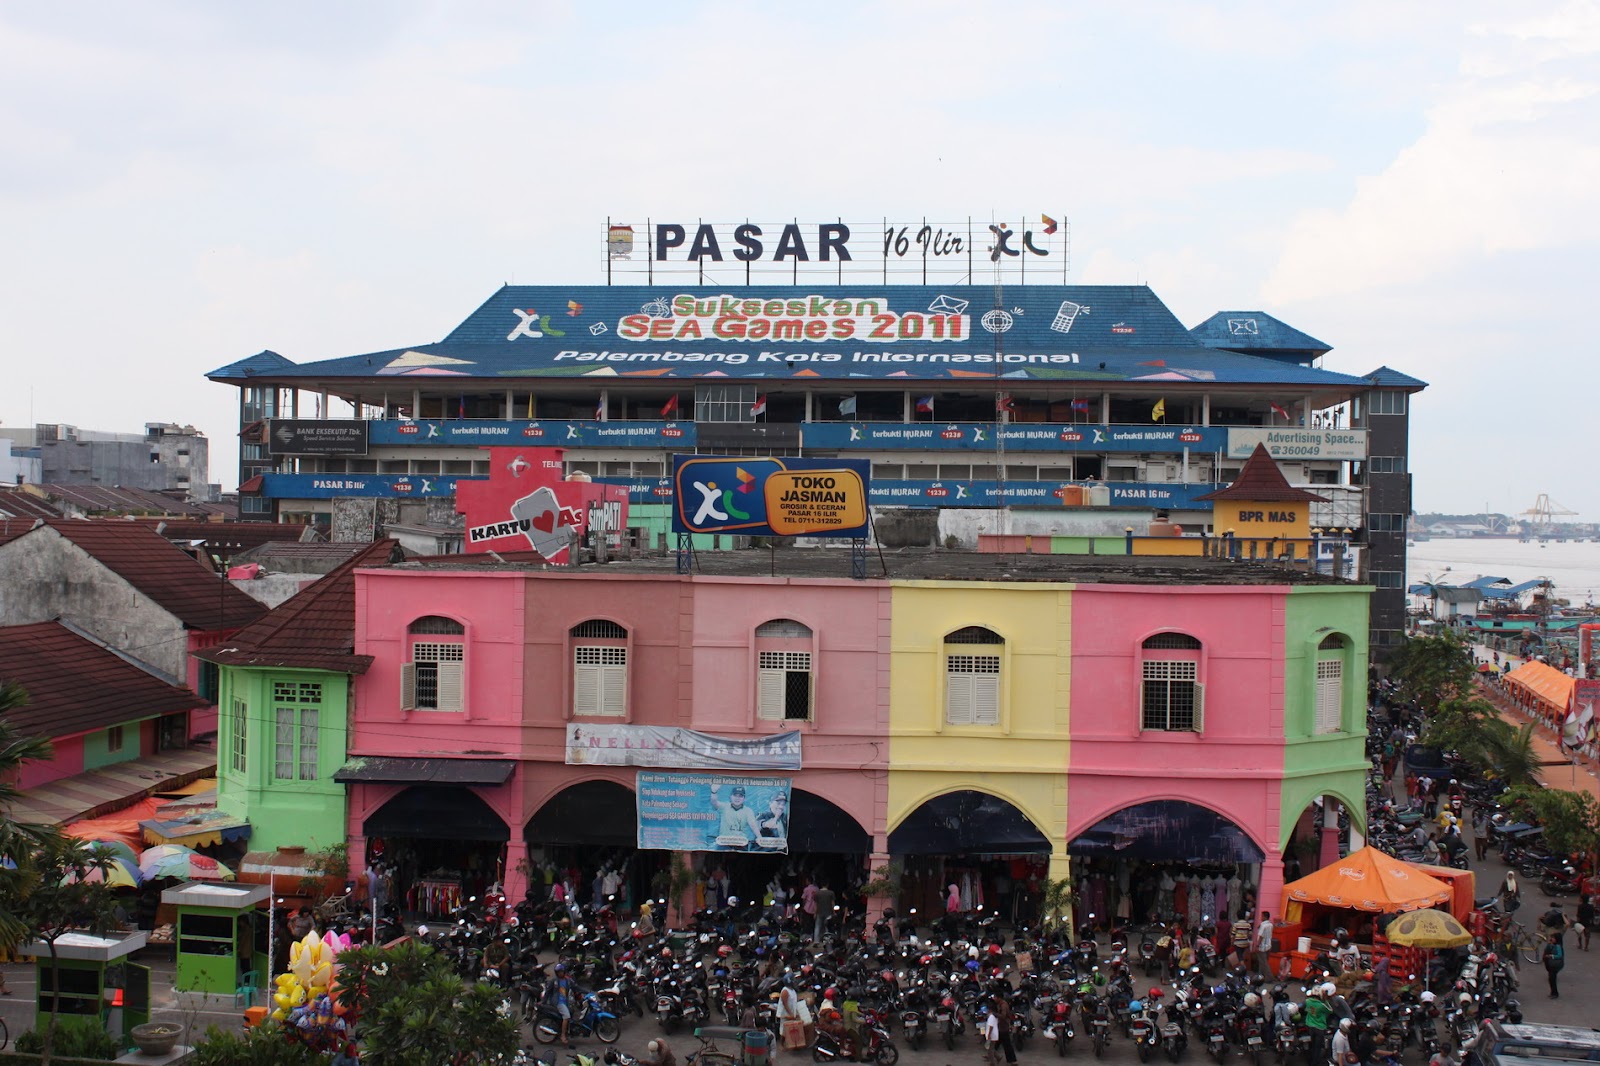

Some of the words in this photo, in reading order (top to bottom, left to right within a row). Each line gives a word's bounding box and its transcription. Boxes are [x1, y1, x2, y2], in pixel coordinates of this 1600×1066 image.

[656, 223, 853, 262] PASAR
[885, 226, 910, 257] 16
[672, 295, 881, 318] Sukseskan
[620, 315, 703, 339] SEA
[711, 315, 855, 340] Games
[868, 314, 963, 340] 2011
[553, 350, 750, 364] Palembang
[757, 350, 842, 363] Kota
[852, 350, 1080, 364] Internasional
[452, 427, 480, 435] terbukti
[481, 427, 509, 435] MURAH!
[598, 428, 627, 436] terbukti
[627, 427, 657, 436] MURAH!
[872, 430, 901, 438] terbukti
[903, 430, 933, 439] MURAH!
[996, 431, 1025, 439] terbukti
[1026, 431, 1057, 439] MURAH!
[1113, 432, 1143, 440] terbukti
[1144, 432, 1175, 440] MURAH!
[1267, 432, 1322, 445] Advertising
[1282, 446, 1320, 455] 360049
[313, 480, 343, 489] PASAR
[345, 480, 353, 489] 16
[791, 476, 836, 489] TOKO
[780, 490, 846, 503] JASMAN
[868, 487, 889, 496] rbukti
[891, 487, 921, 496] MURAH!
[1016, 488, 1047, 496] MURAH!
[1114, 489, 1146, 498] PASAR
[1148, 489, 1157, 498] 16
[1239, 510, 1264, 522] BPR
[1268, 511, 1296, 523] MAS
[471, 518, 531, 541] KARTU
[589, 736, 668, 751] NELLY
